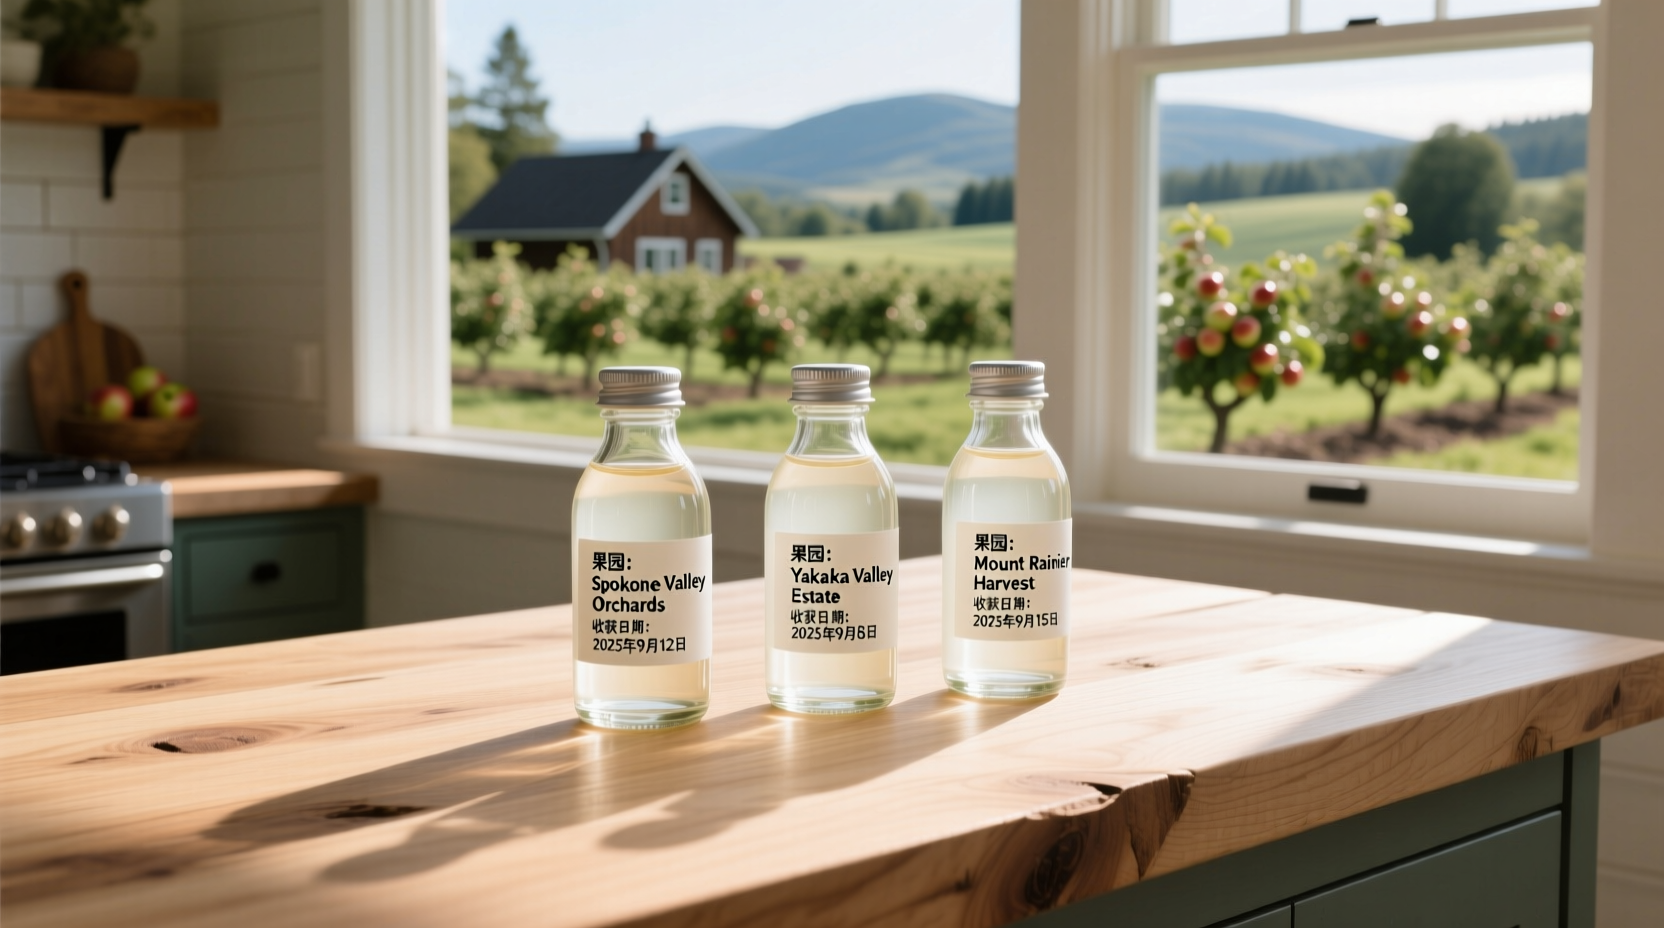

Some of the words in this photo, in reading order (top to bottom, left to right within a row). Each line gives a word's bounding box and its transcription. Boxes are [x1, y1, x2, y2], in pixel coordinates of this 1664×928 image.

[975, 556, 1024, 571] Mount
[1030, 554, 1070, 570] Rainier
[592, 575, 661, 594] Spokone
[664, 573, 705, 592] Valley
[791, 567, 849, 584] Yakaka
[852, 565, 893, 585] Valley
[974, 575, 1035, 591] Harvest
[592, 596, 665, 613] Orchards
[792, 588, 840, 604] Estate
[973, 612, 1057, 629] 2025年9月15日
[593, 637, 685, 654] 2025年9月12日
